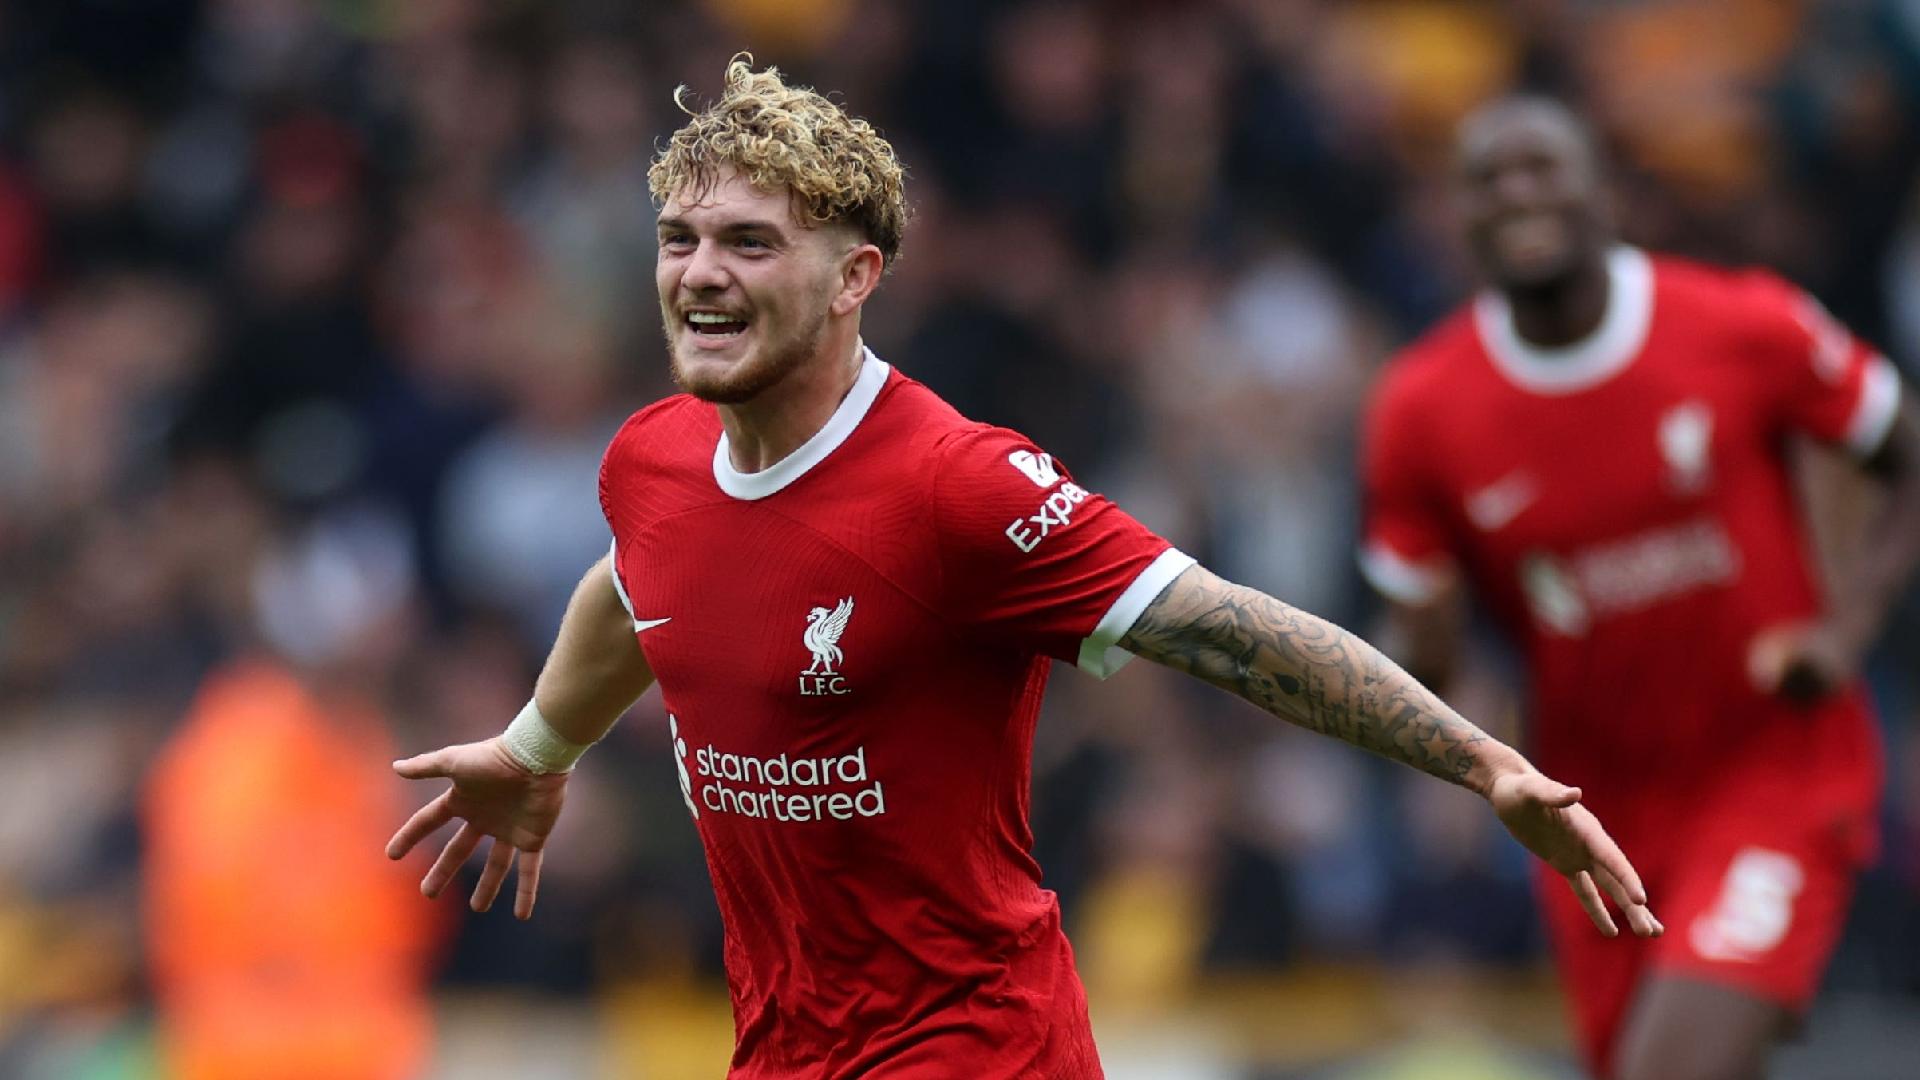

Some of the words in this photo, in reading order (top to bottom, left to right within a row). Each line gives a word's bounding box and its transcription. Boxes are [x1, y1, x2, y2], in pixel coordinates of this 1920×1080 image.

[1005, 481, 1090, 553] Expe
[799, 676, 852, 696] L.F.C.
[696, 744, 867, 786] standard
[702, 780, 886, 822] chartered
